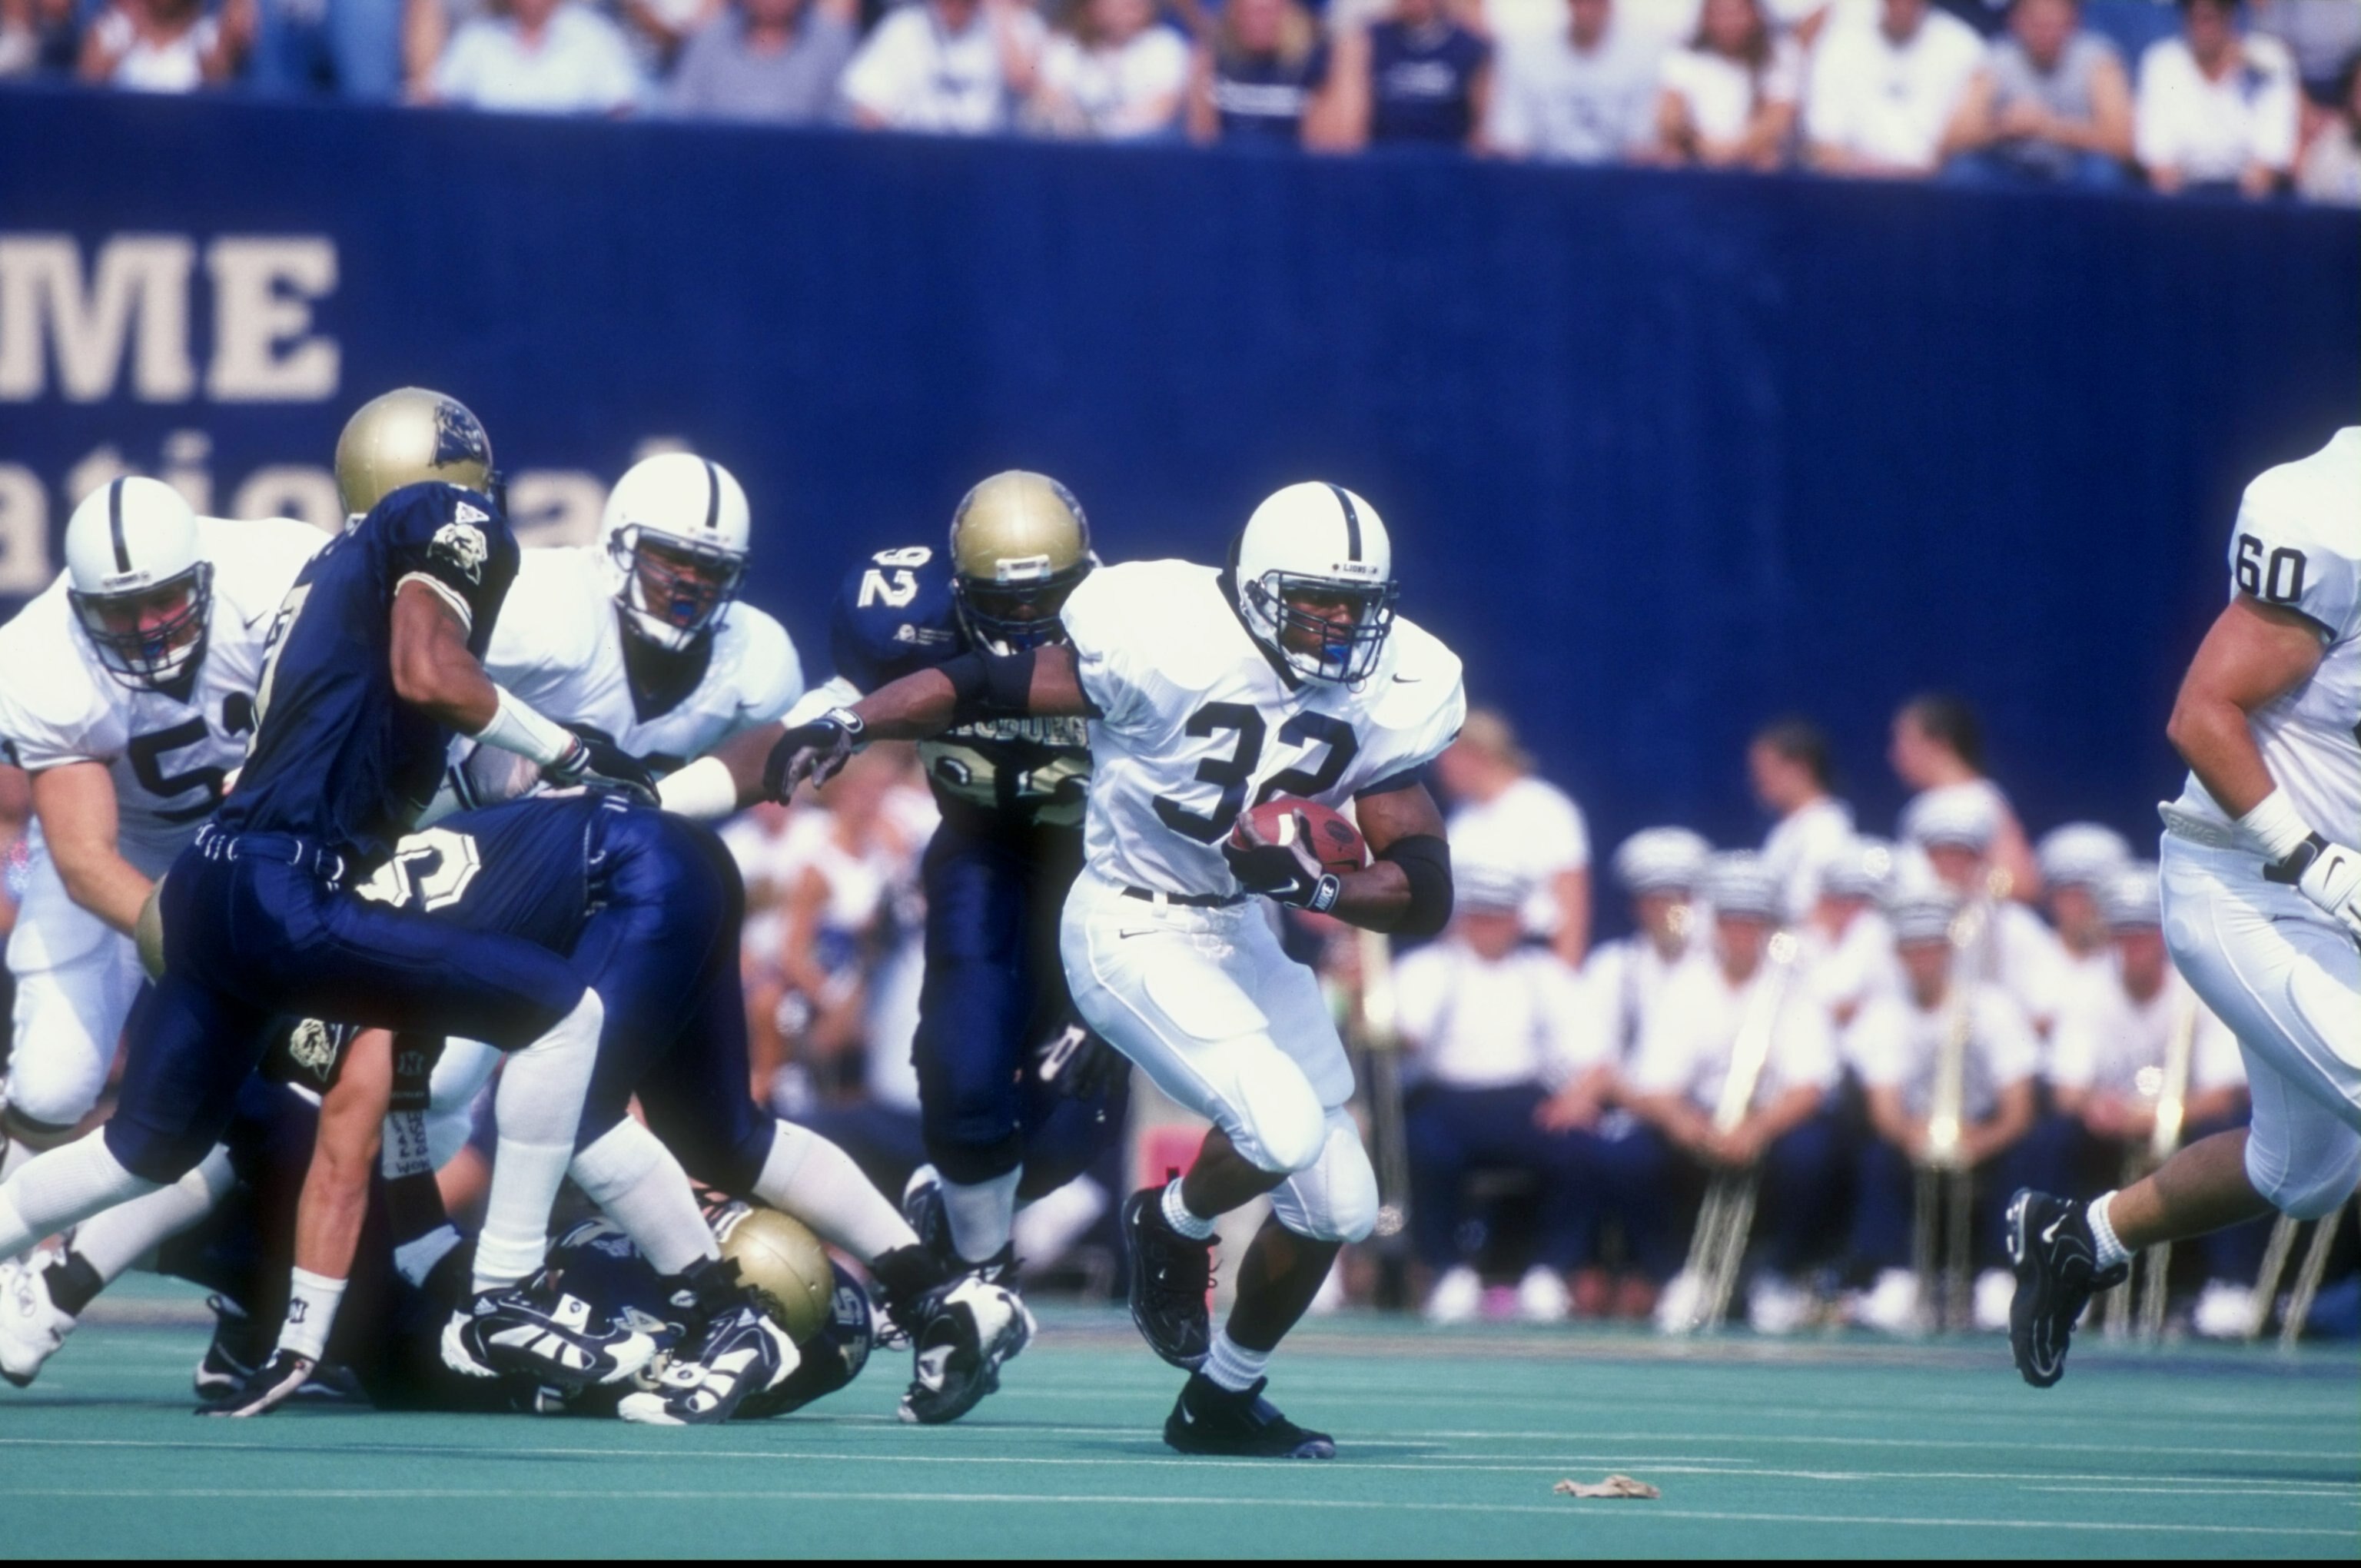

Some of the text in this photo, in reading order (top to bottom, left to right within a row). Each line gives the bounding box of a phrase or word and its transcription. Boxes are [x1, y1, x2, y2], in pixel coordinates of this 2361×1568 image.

[857, 546, 932, 608] 92
[2236, 533, 2307, 603] 60
[1151, 701, 1360, 845] 32
[1314, 882, 1335, 911] NIKE
